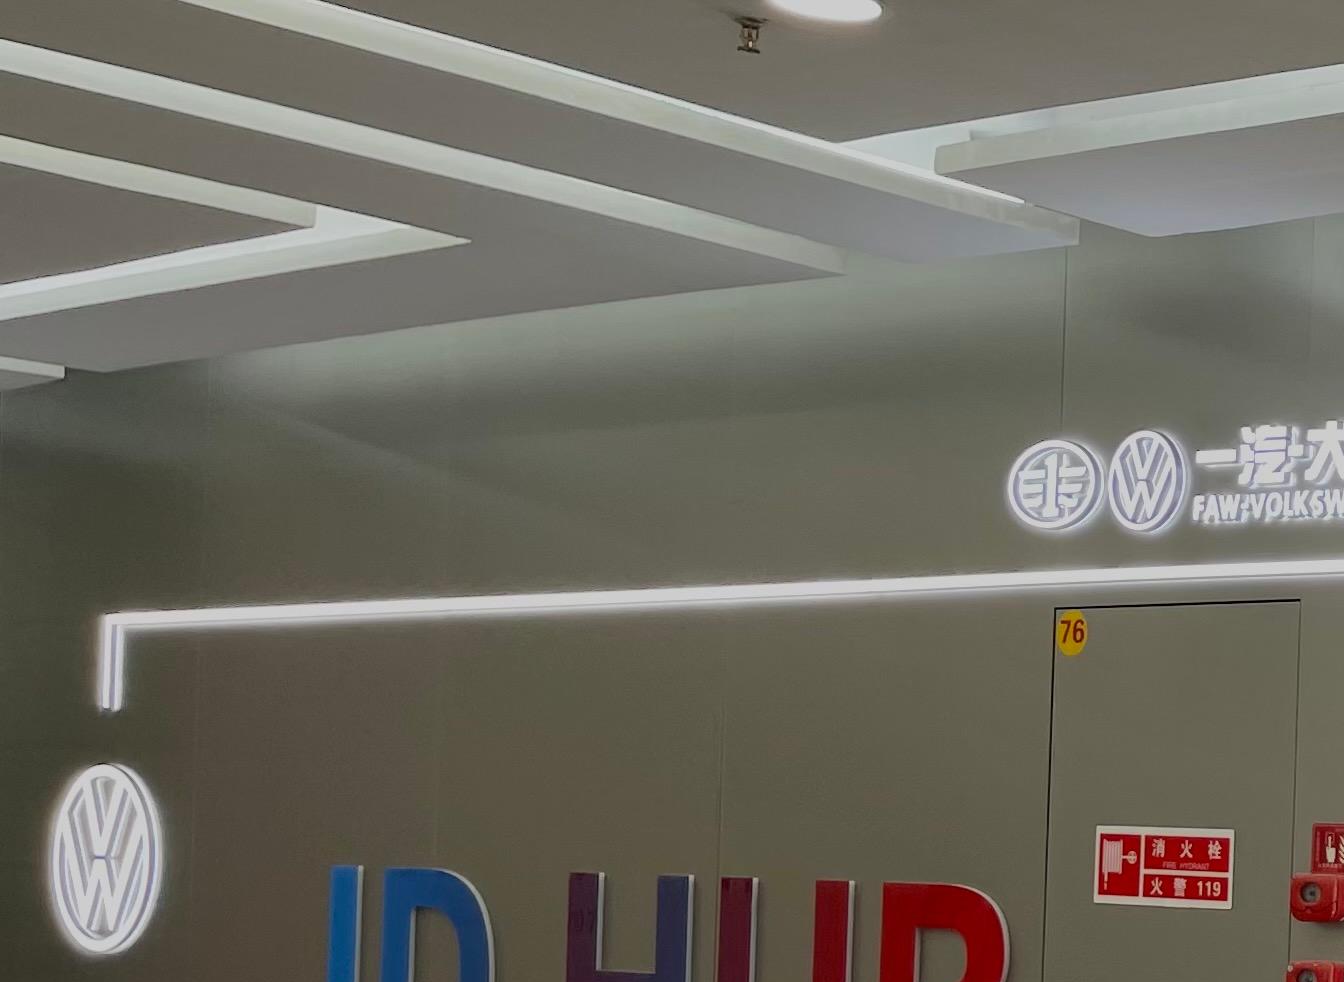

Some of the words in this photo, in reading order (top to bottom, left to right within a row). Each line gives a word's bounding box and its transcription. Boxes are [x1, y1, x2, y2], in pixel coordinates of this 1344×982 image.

[1060, 619, 1085, 644] 76
[1152, 838, 1222, 860] 消火栓
[1150, 877, 1187, 897] 火警
[1197, 881, 1221, 897] 119
